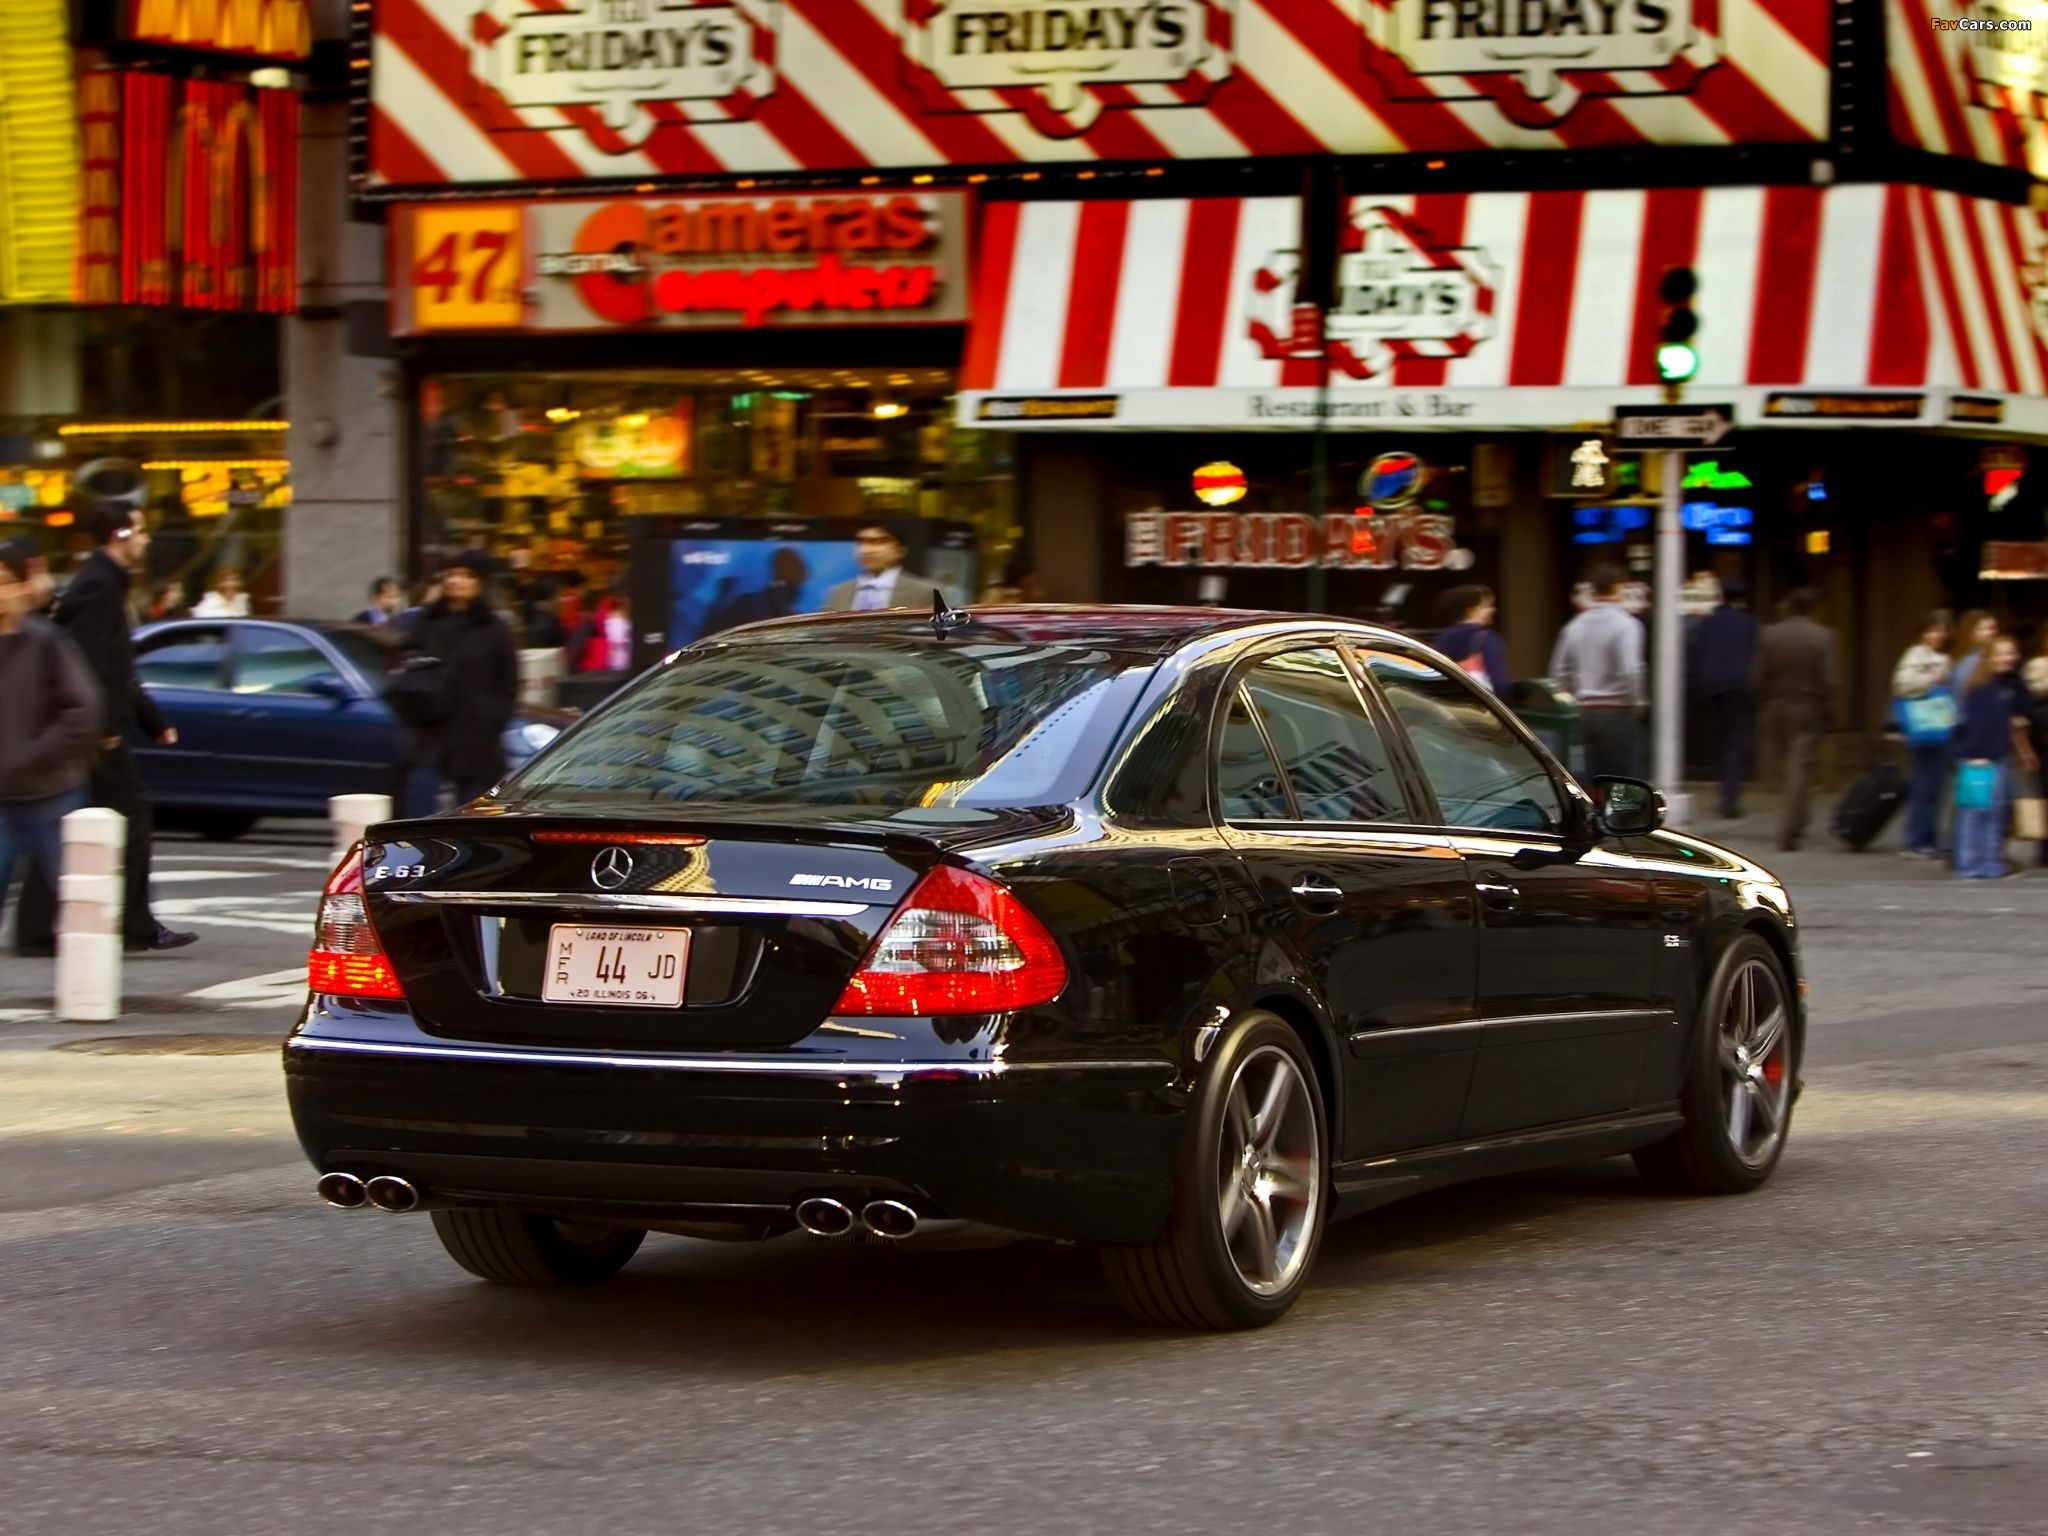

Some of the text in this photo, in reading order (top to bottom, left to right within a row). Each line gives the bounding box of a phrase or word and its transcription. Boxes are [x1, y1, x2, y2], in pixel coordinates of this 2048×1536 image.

[1418, 0, 1670, 40] FRIDAYS
[514, 20, 732, 74] FRIDAY'S
[412, 230, 511, 304] 47
[1250, 394, 1475, 418] Restaurant & Bar
[585, 931, 653, 942] LAND OF LINCOLN
[596, 945, 626, 984] 44
[648, 954, 676, 980] JD
[576, 988, 589, 998] 20
[594, 989, 631, 999] ILLINOIS
